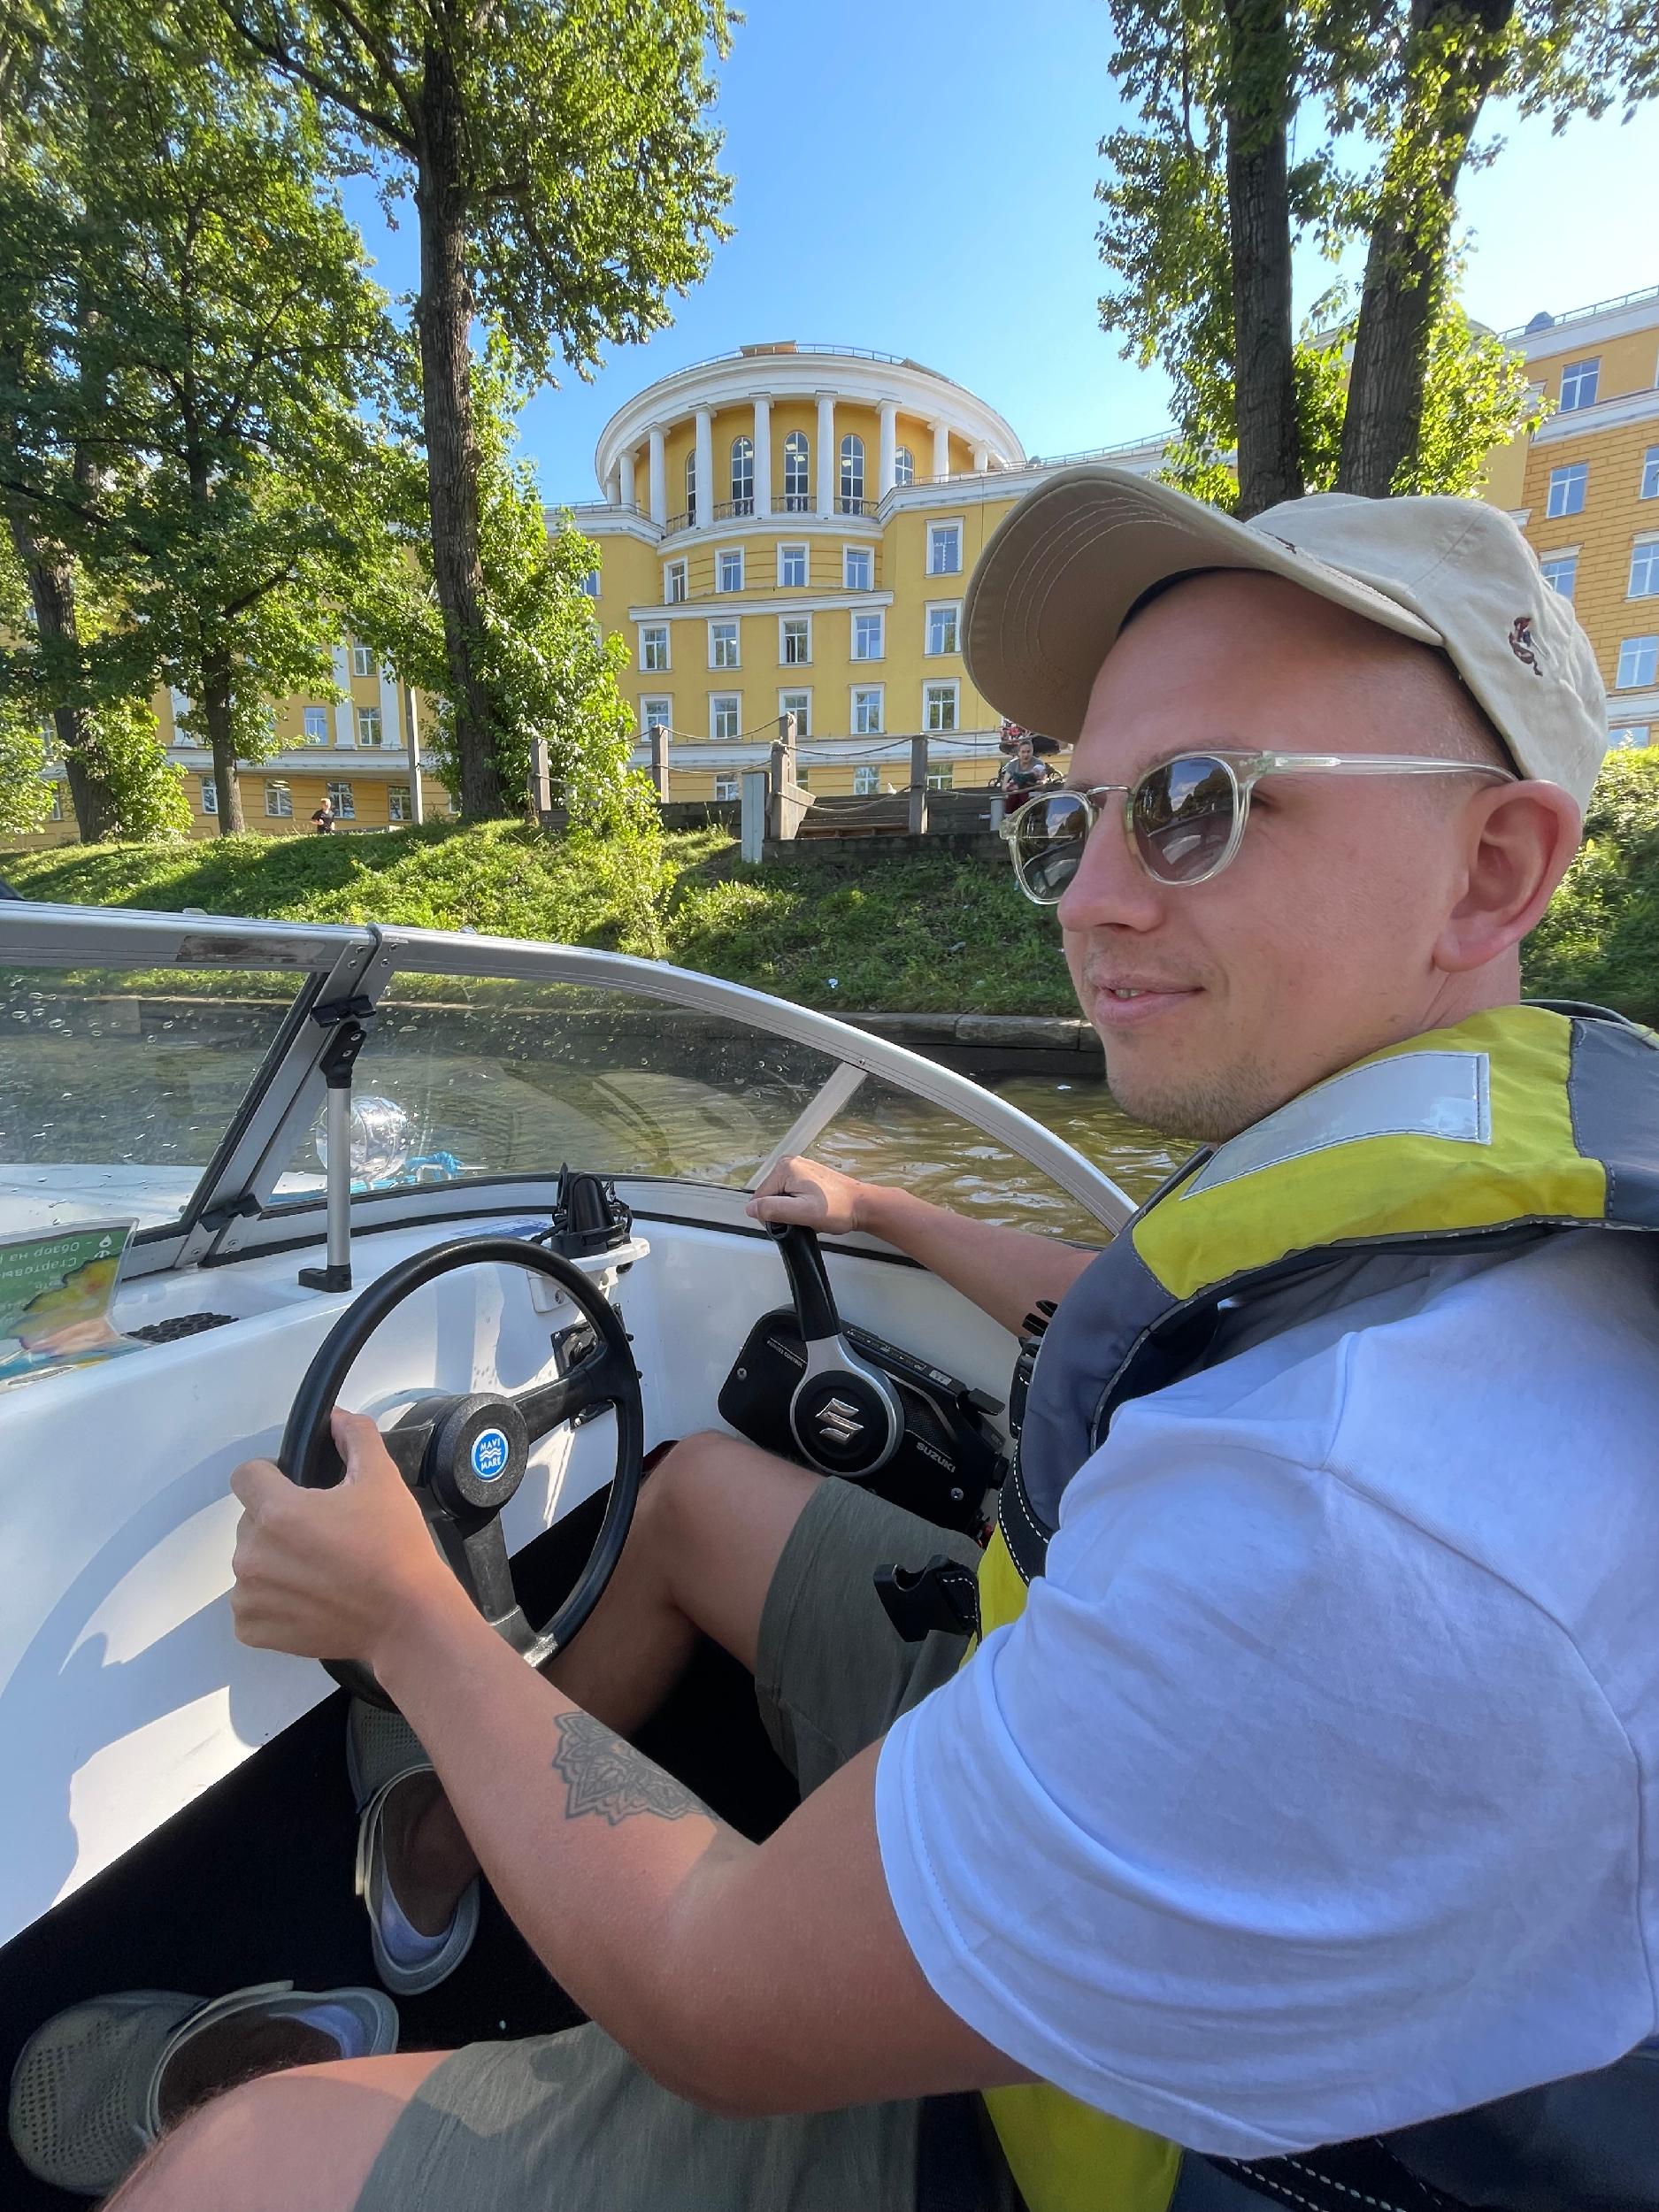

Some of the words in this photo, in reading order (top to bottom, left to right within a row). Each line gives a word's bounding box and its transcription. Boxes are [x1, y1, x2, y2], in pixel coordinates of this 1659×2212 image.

[34, 1241, 80, 1257] Обзор
[9, 1252, 28, 1262] на
[0, 1256, 77, 1279] Стартовы
[480, 1438, 501, 1452] MAVI
[480, 1456, 502, 1471] MARE
[916, 1441, 956, 1473] SUZUKI
